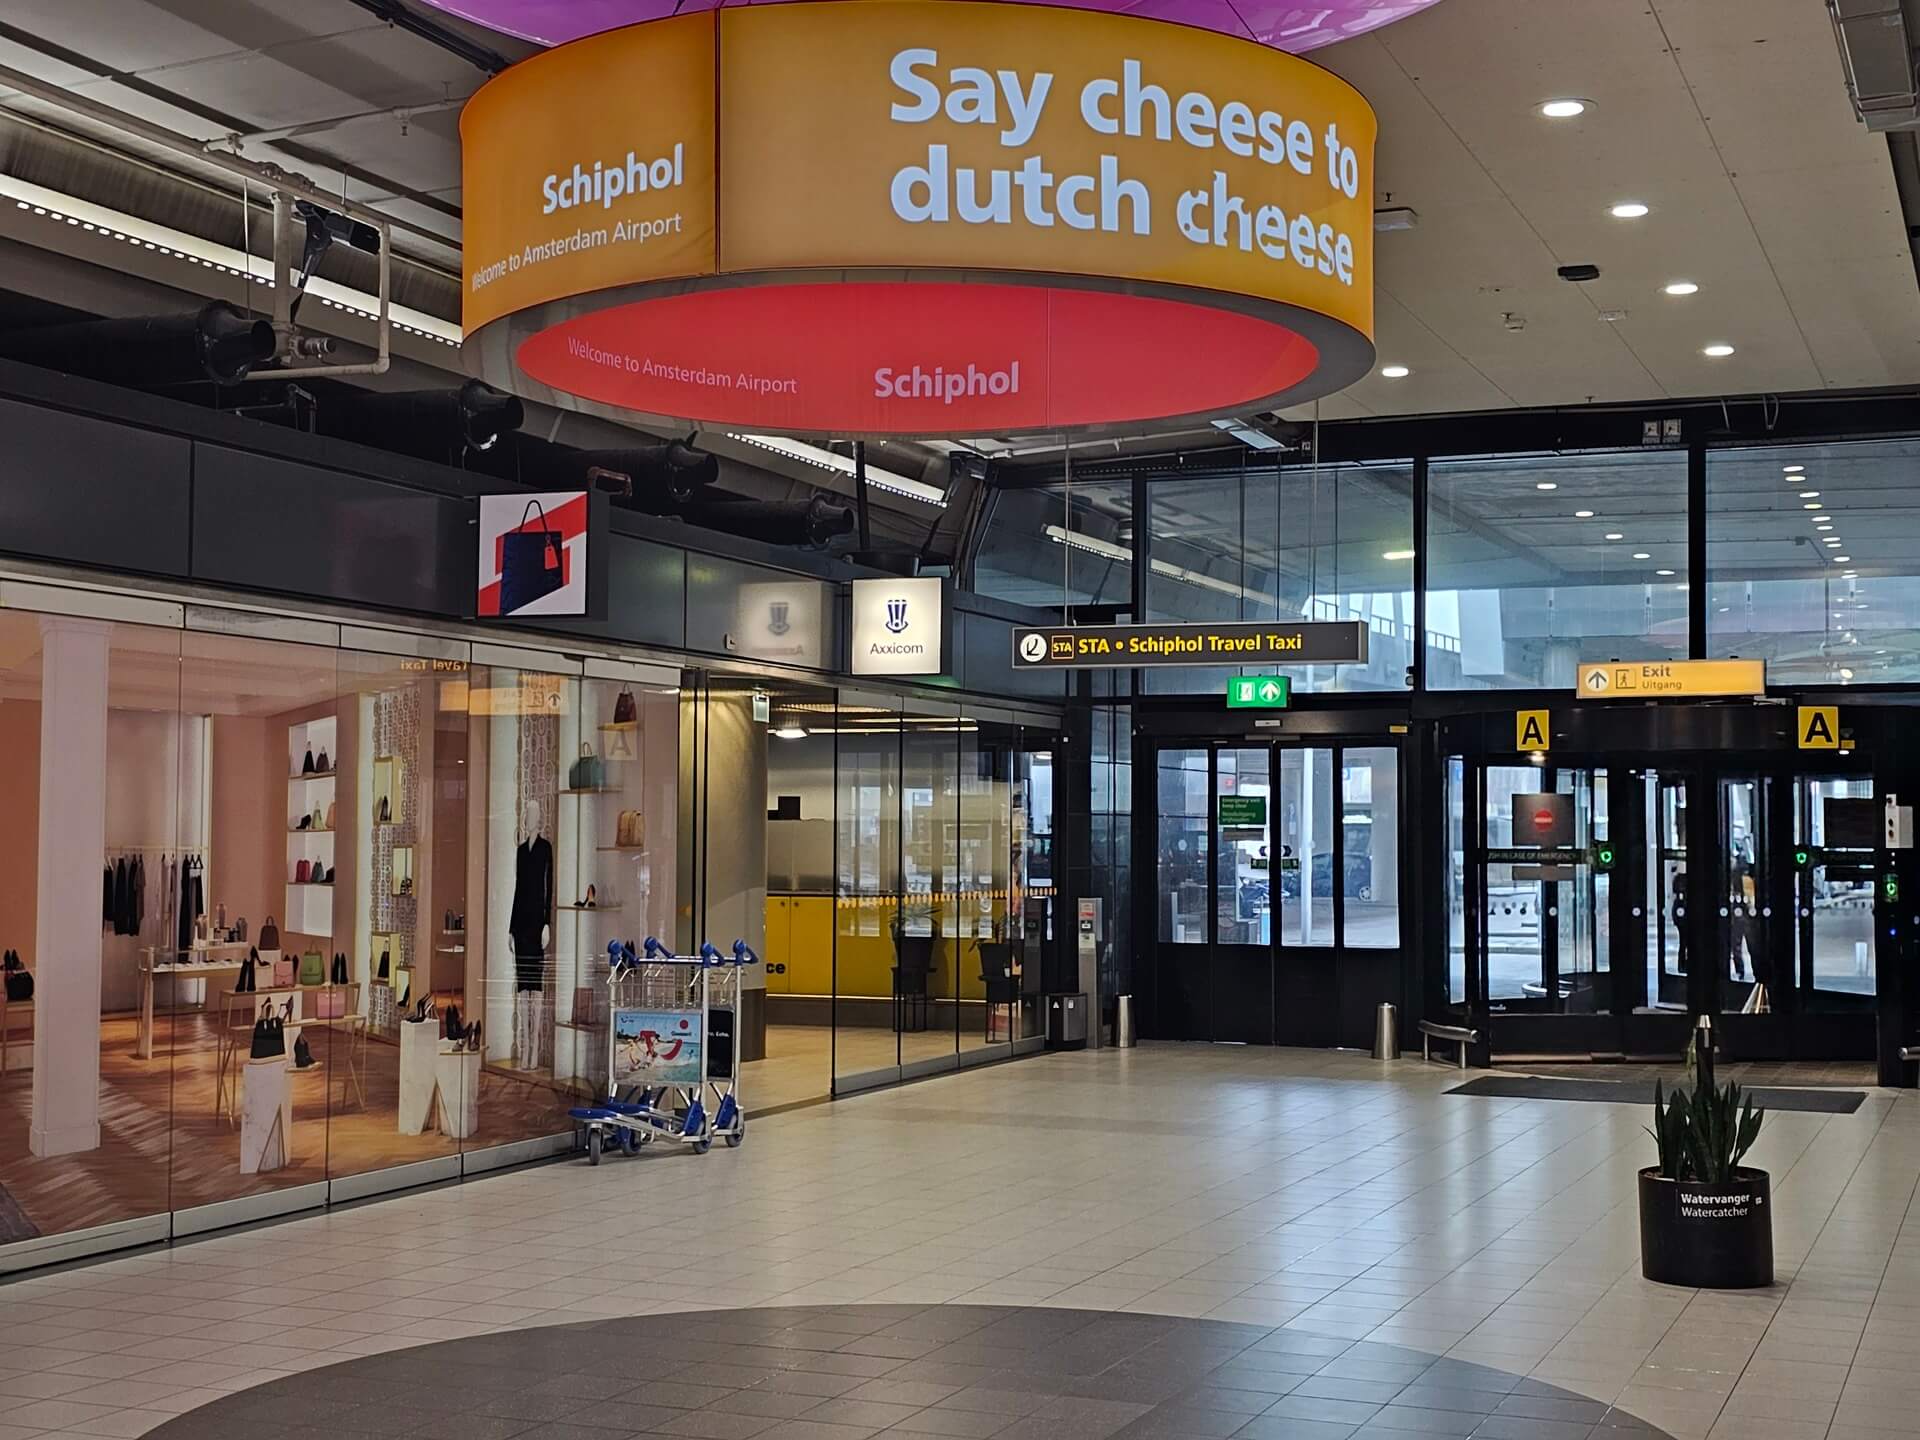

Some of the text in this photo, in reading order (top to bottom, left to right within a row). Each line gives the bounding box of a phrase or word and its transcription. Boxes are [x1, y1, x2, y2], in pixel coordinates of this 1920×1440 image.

[889, 48, 1359, 199] Say cheese to
[543, 143, 683, 214] Schiphol
[890, 144, 1355, 287] dutch cheese
[471, 212, 682, 293] Welcome to Amsterdam Airport
[568, 337, 798, 396] Welcome to Amsterdam Airport
[874, 360, 1020, 404] Schiphol
[870, 642, 924, 654] Axxicom
[1053, 633, 1302, 656] STA STA Schiphol Travel Taxi
[1642, 665, 1671, 678] Exit
[1642, 680, 1682, 692] Uitgang
[1521, 716, 1544, 745] A
[1804, 712, 1834, 743] A
[1680, 1193, 1751, 1206] Watervanger
[1680, 1206, 1748, 1218] Watercatcher
